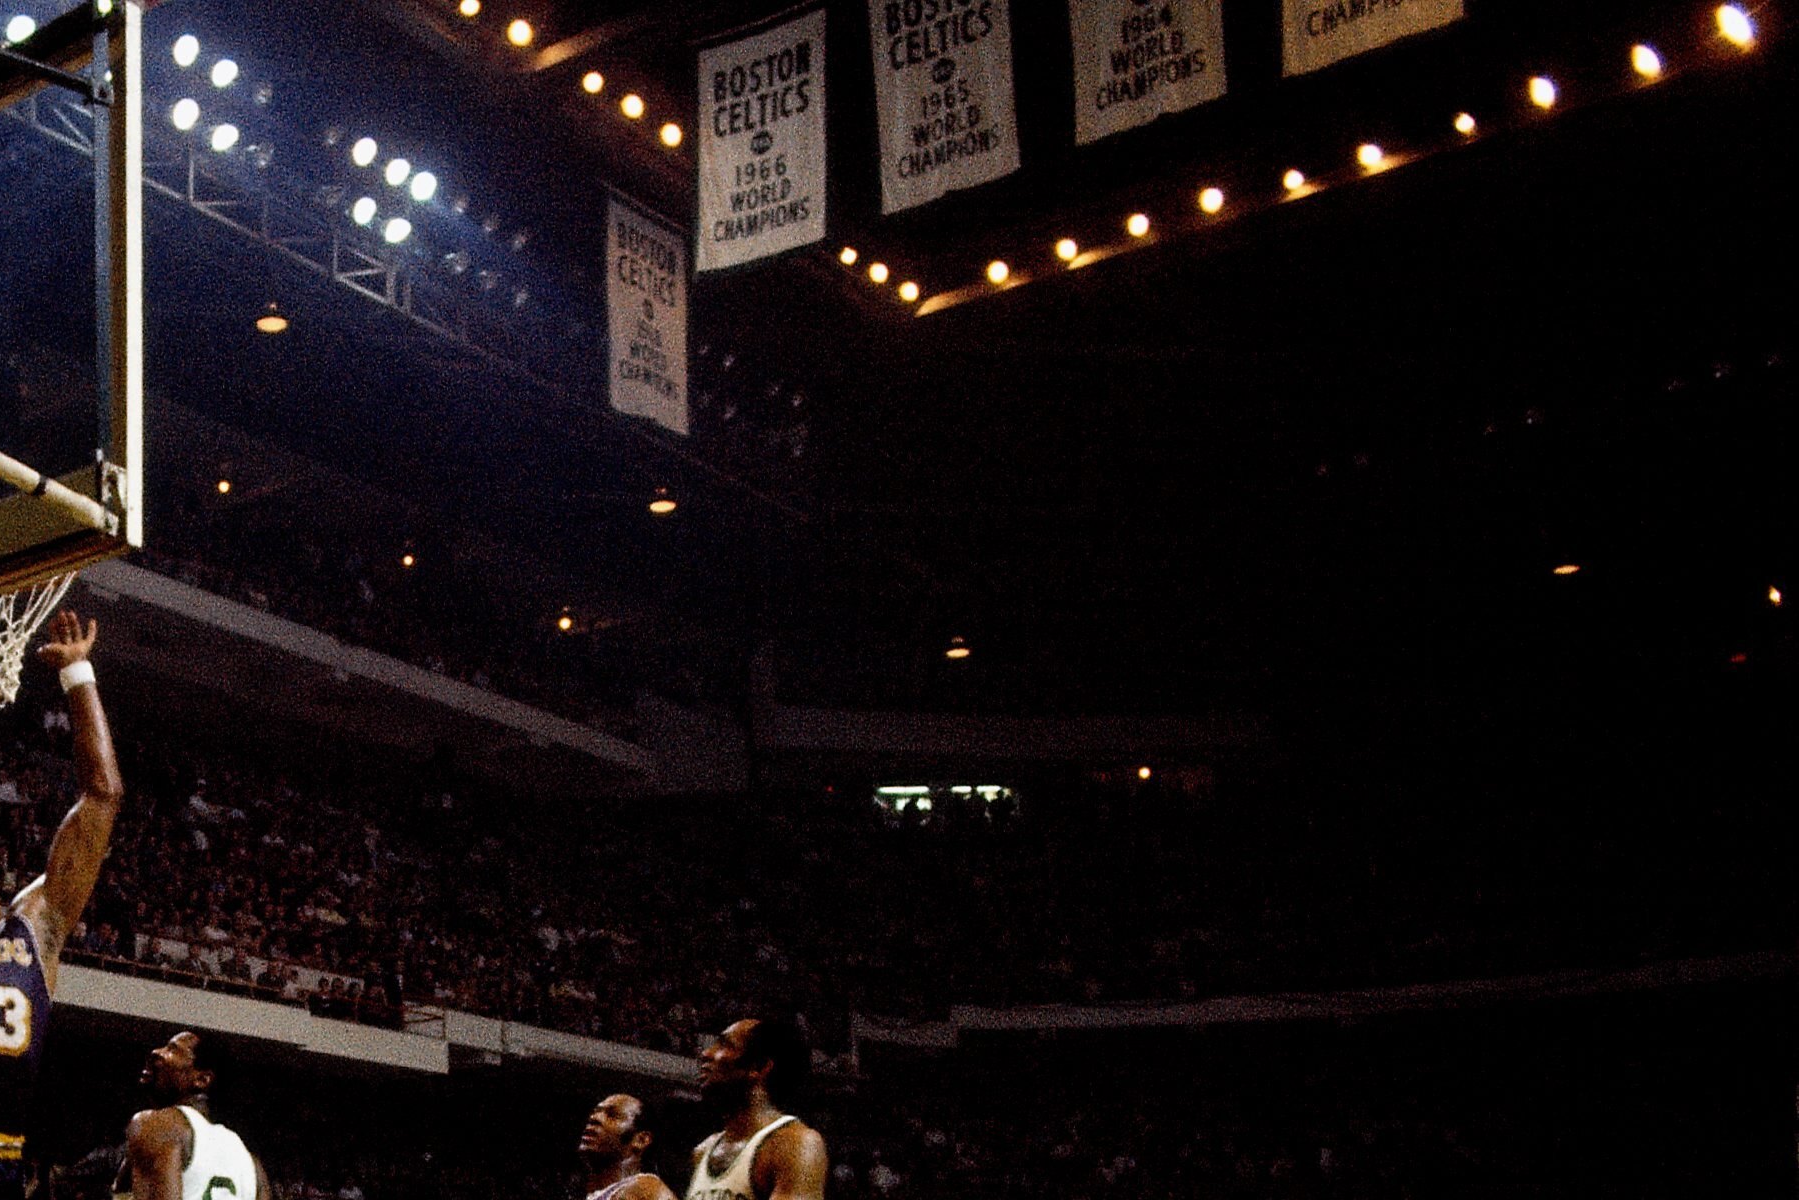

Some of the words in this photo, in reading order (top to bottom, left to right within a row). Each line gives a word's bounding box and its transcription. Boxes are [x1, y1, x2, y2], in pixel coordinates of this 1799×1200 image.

[888, 1, 993, 71] CELTICS
[1122, 4, 1173, 44] 1964
[712, 38, 811, 103] BOSTON
[1110, 30, 1184, 75] WORLD
[921, 76, 970, 119] 1965
[1096, 49, 1206, 111] CHAMPIONS
[712, 78, 810, 138] CELTICS
[912, 103, 981, 148] WORLD
[735, 154, 788, 186] 1966
[898, 122, 1000, 179] CHAMPIONS
[730, 177, 792, 214] WORLD
[712, 196, 811, 242] CHAMPIONS
